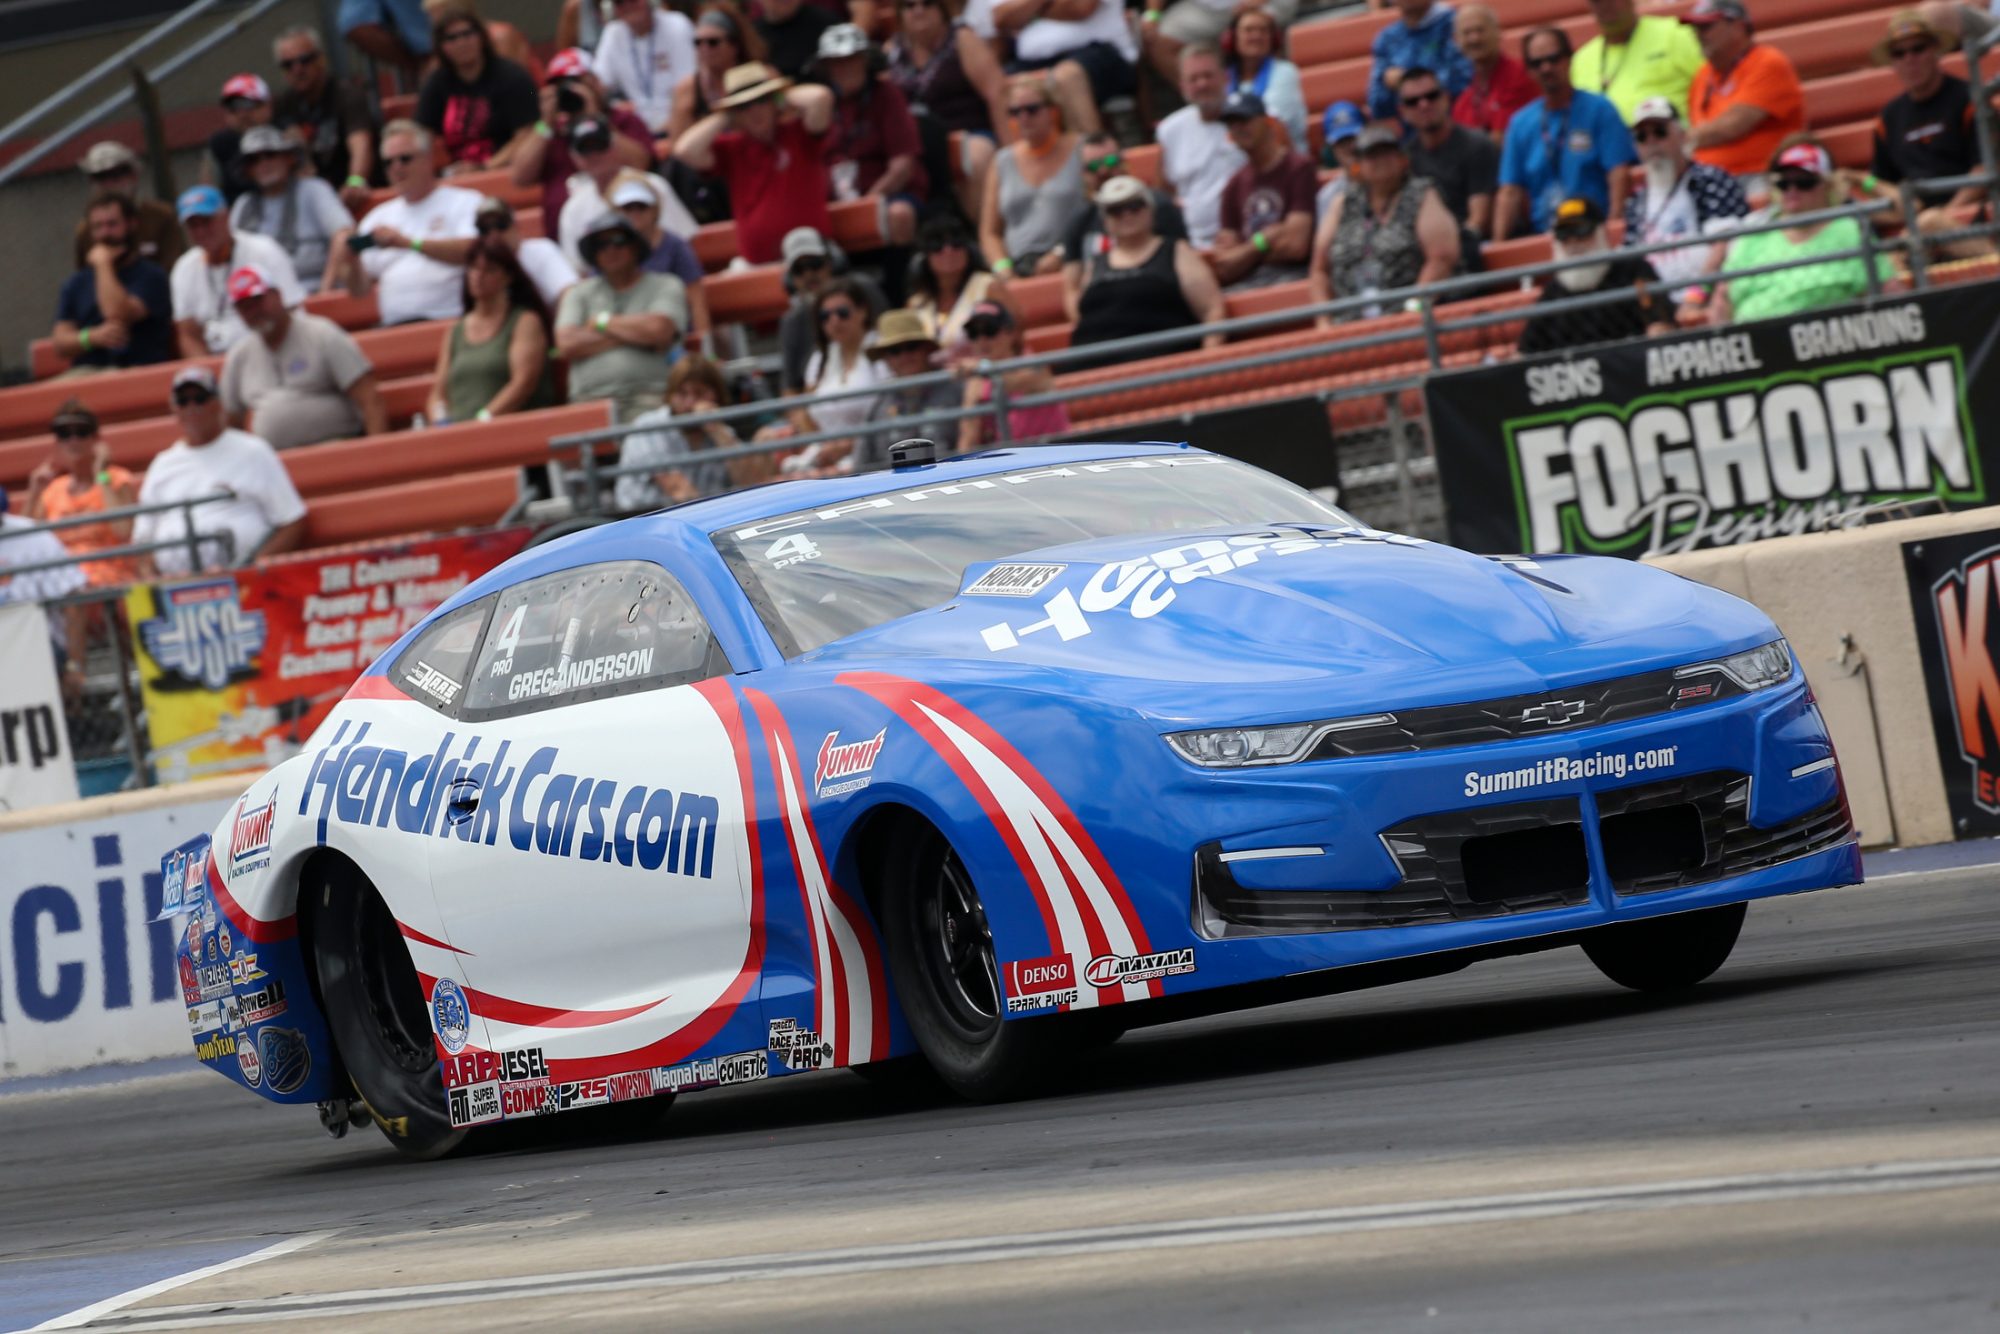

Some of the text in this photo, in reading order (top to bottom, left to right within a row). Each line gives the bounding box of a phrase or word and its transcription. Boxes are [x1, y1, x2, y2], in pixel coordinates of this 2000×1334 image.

[1526, 303, 1924, 405] SIGNS APPAREL BRANDING
[1515, 361, 1971, 554] FOGHORN
[1626, 490, 1870, 560] Designs
[764, 533, 818, 559] 4
[772, 550, 823, 571] PRO
[976, 566, 1060, 588] HOGAN'S
[496, 603, 528, 658] 4
[490, 657, 514, 678] PRO
[508, 647, 655, 700] GREG ANDERSON
[1678, 684, 1712, 700] SS
[0, 703, 59, 771] rp
[299, 719, 719, 879] HendrickCars.com
[244, 857, 271, 874] EQUIPMENT
[1023, 963, 1068, 985] DENSO
[1114, 948, 1195, 975] MAXIMA
[1123, 964, 1196, 983] RACING OILS
[1008, 989, 1079, 1013] SPARK PLUGS
[769, 1019, 794, 1031] FORGED
[195, 1033, 236, 1062] GOODYEAR
[769, 1031, 818, 1049] RACE STAR
[443, 1052, 494, 1089] ARP
[498, 1047, 549, 1081] JESEL
[719, 1054, 768, 1083] COMETIC
[792, 1046, 822, 1069] PRO
[609, 1069, 651, 1103] SIMPSON
[652, 1057, 718, 1092] MagnaFuel
[449, 1087, 471, 1126] ATI
[473, 1085, 494, 1102] SUPER
[502, 1086, 546, 1115] COMP
[471, 1100, 500, 1118] DAMPER
[534, 1103, 557, 1117] CAMS
